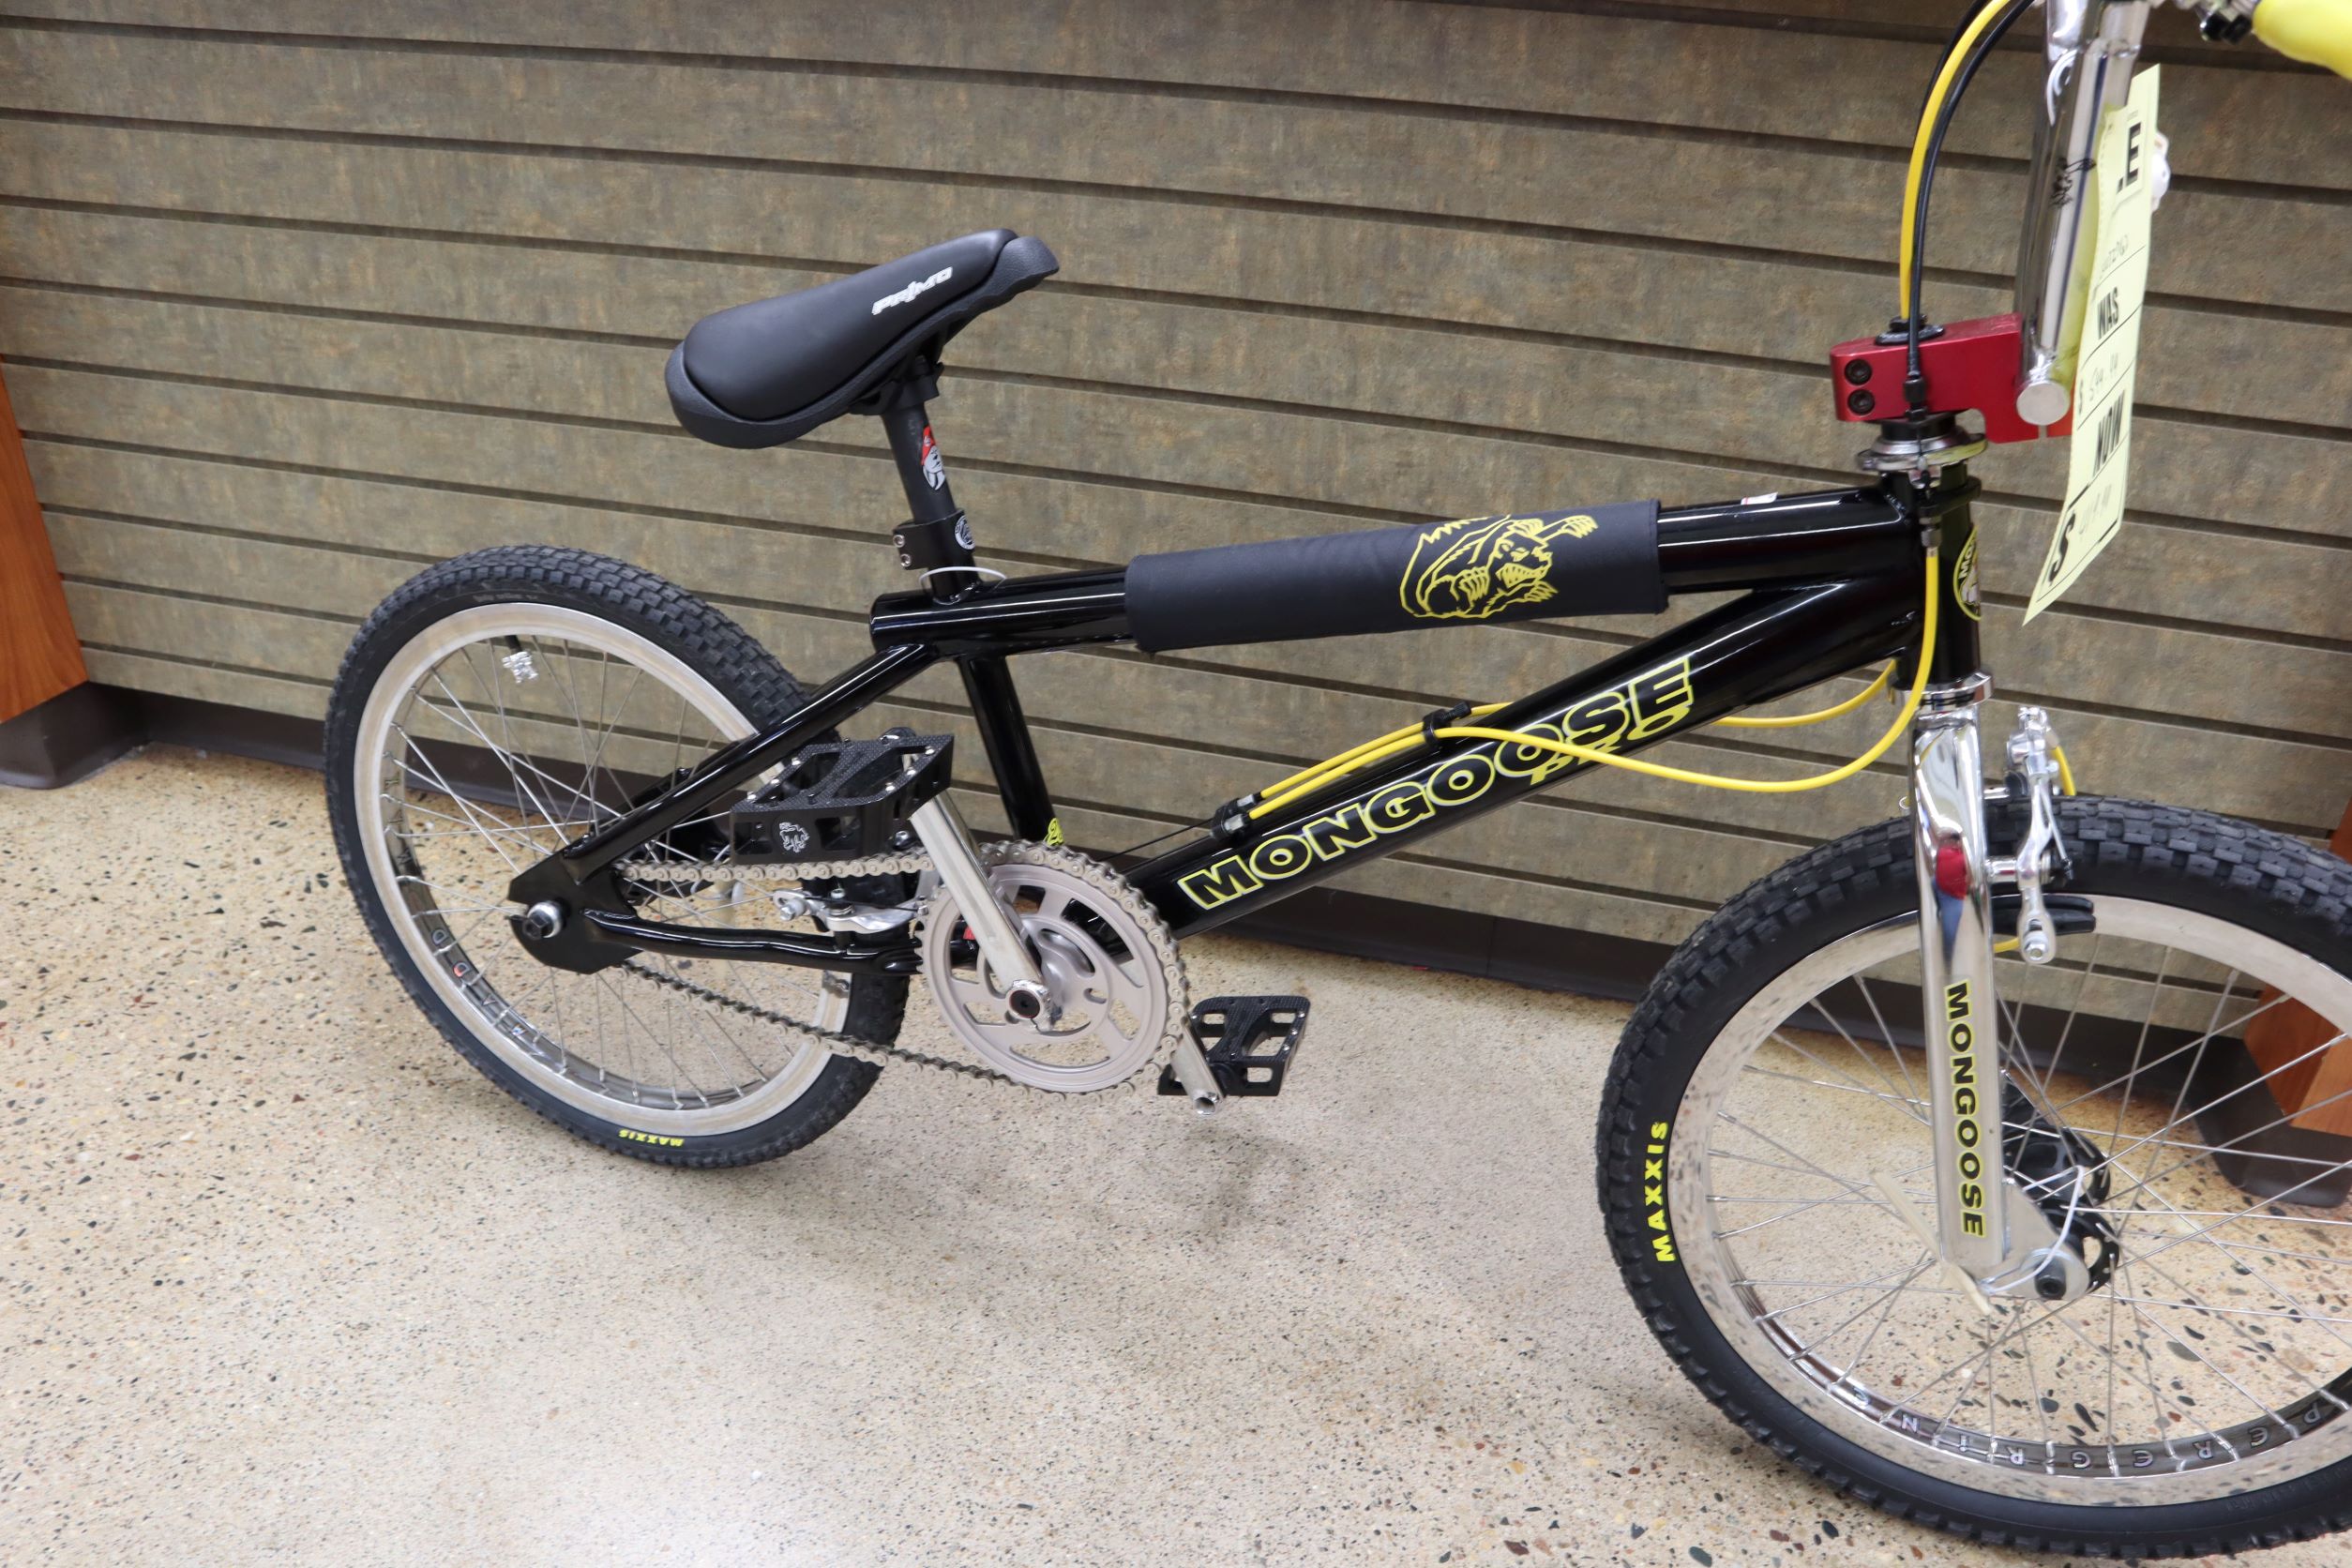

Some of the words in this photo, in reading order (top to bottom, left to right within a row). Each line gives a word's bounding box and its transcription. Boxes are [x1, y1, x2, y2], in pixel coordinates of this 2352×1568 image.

[2098, 287, 2118, 340] WAS
[2093, 389, 2125, 477] NOW
[1177, 656, 1694, 910] MONGOOSE
[618, 1128, 685, 1147] MAXXIS
[1944, 979, 1985, 1237] MONGOOSE
[1645, 1122, 1677, 1262] MAXXIS
